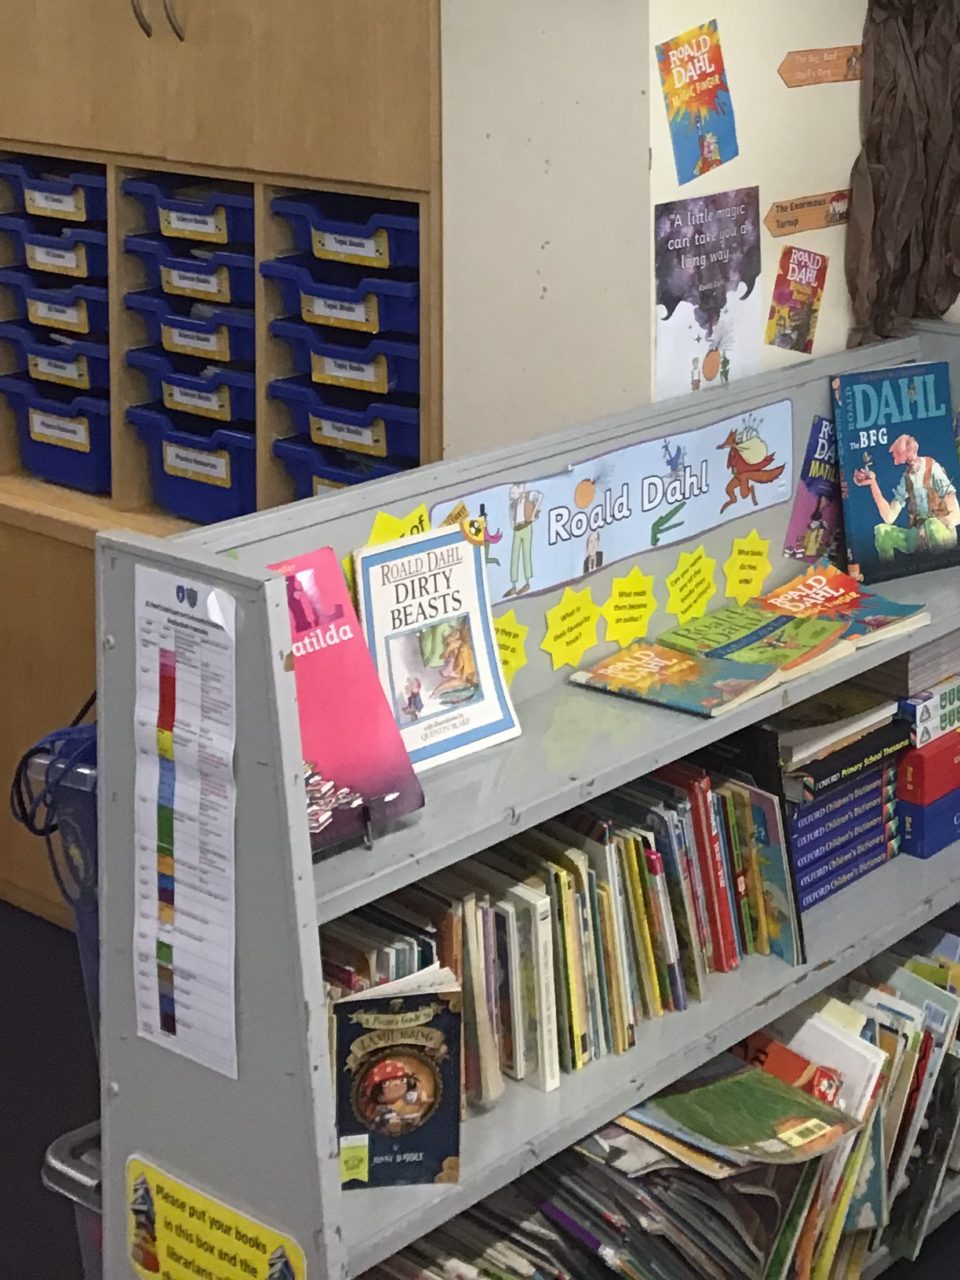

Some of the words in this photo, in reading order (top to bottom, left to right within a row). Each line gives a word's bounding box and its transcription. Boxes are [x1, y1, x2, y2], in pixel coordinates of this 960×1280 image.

[668, 35, 712, 69] ROALD
[671, 52, 716, 90] DAHL
[687, 206, 713, 223] little
[716, 202, 746, 221] magic
[774, 204, 789, 215] The
[790, 198, 827, 211] Enormous
[667, 234, 691, 251] can
[694, 229, 717, 246] take
[719, 226, 738, 245] you
[740, 223, 748, 236] a
[681, 252, 707, 271] long
[790, 248, 822, 270] ROALD
[786, 262, 818, 287] DAHL
[852, 373, 947, 430] DAHL
[858, 427, 889, 449] BFG
[548, 483, 632, 546] Roald
[640, 459, 710, 513] Dahl
[410, 514, 425, 536] of
[380, 561, 425, 587] ROALD
[427, 546, 464, 575] DAHL
[393, 568, 455, 606] DIRTY
[767, 574, 828, 607] ROALD
[783, 585, 845, 613] DAHL
[390, 589, 463, 631] BEASTS
[292, 623, 354, 657] atilda
[797, 807, 826, 829] OXFORD
[796, 826, 825, 848] OXFORD
[797, 845, 826, 868] OXFORD
[800, 865, 829, 887] OXFORD
[802, 884, 831, 907] OXFORD
[155, 1184, 187, 1212] Please
[188, 1205, 207, 1223] put
[208, 1215, 233, 1236] your
[234, 1225, 268, 1255] books
[163, 1217, 174, 1231] in
[174, 1223, 194, 1244] this
[195, 1236, 216, 1256] box
[217, 1247, 238, 1268] and
[239, 1256, 259, 1277] the
